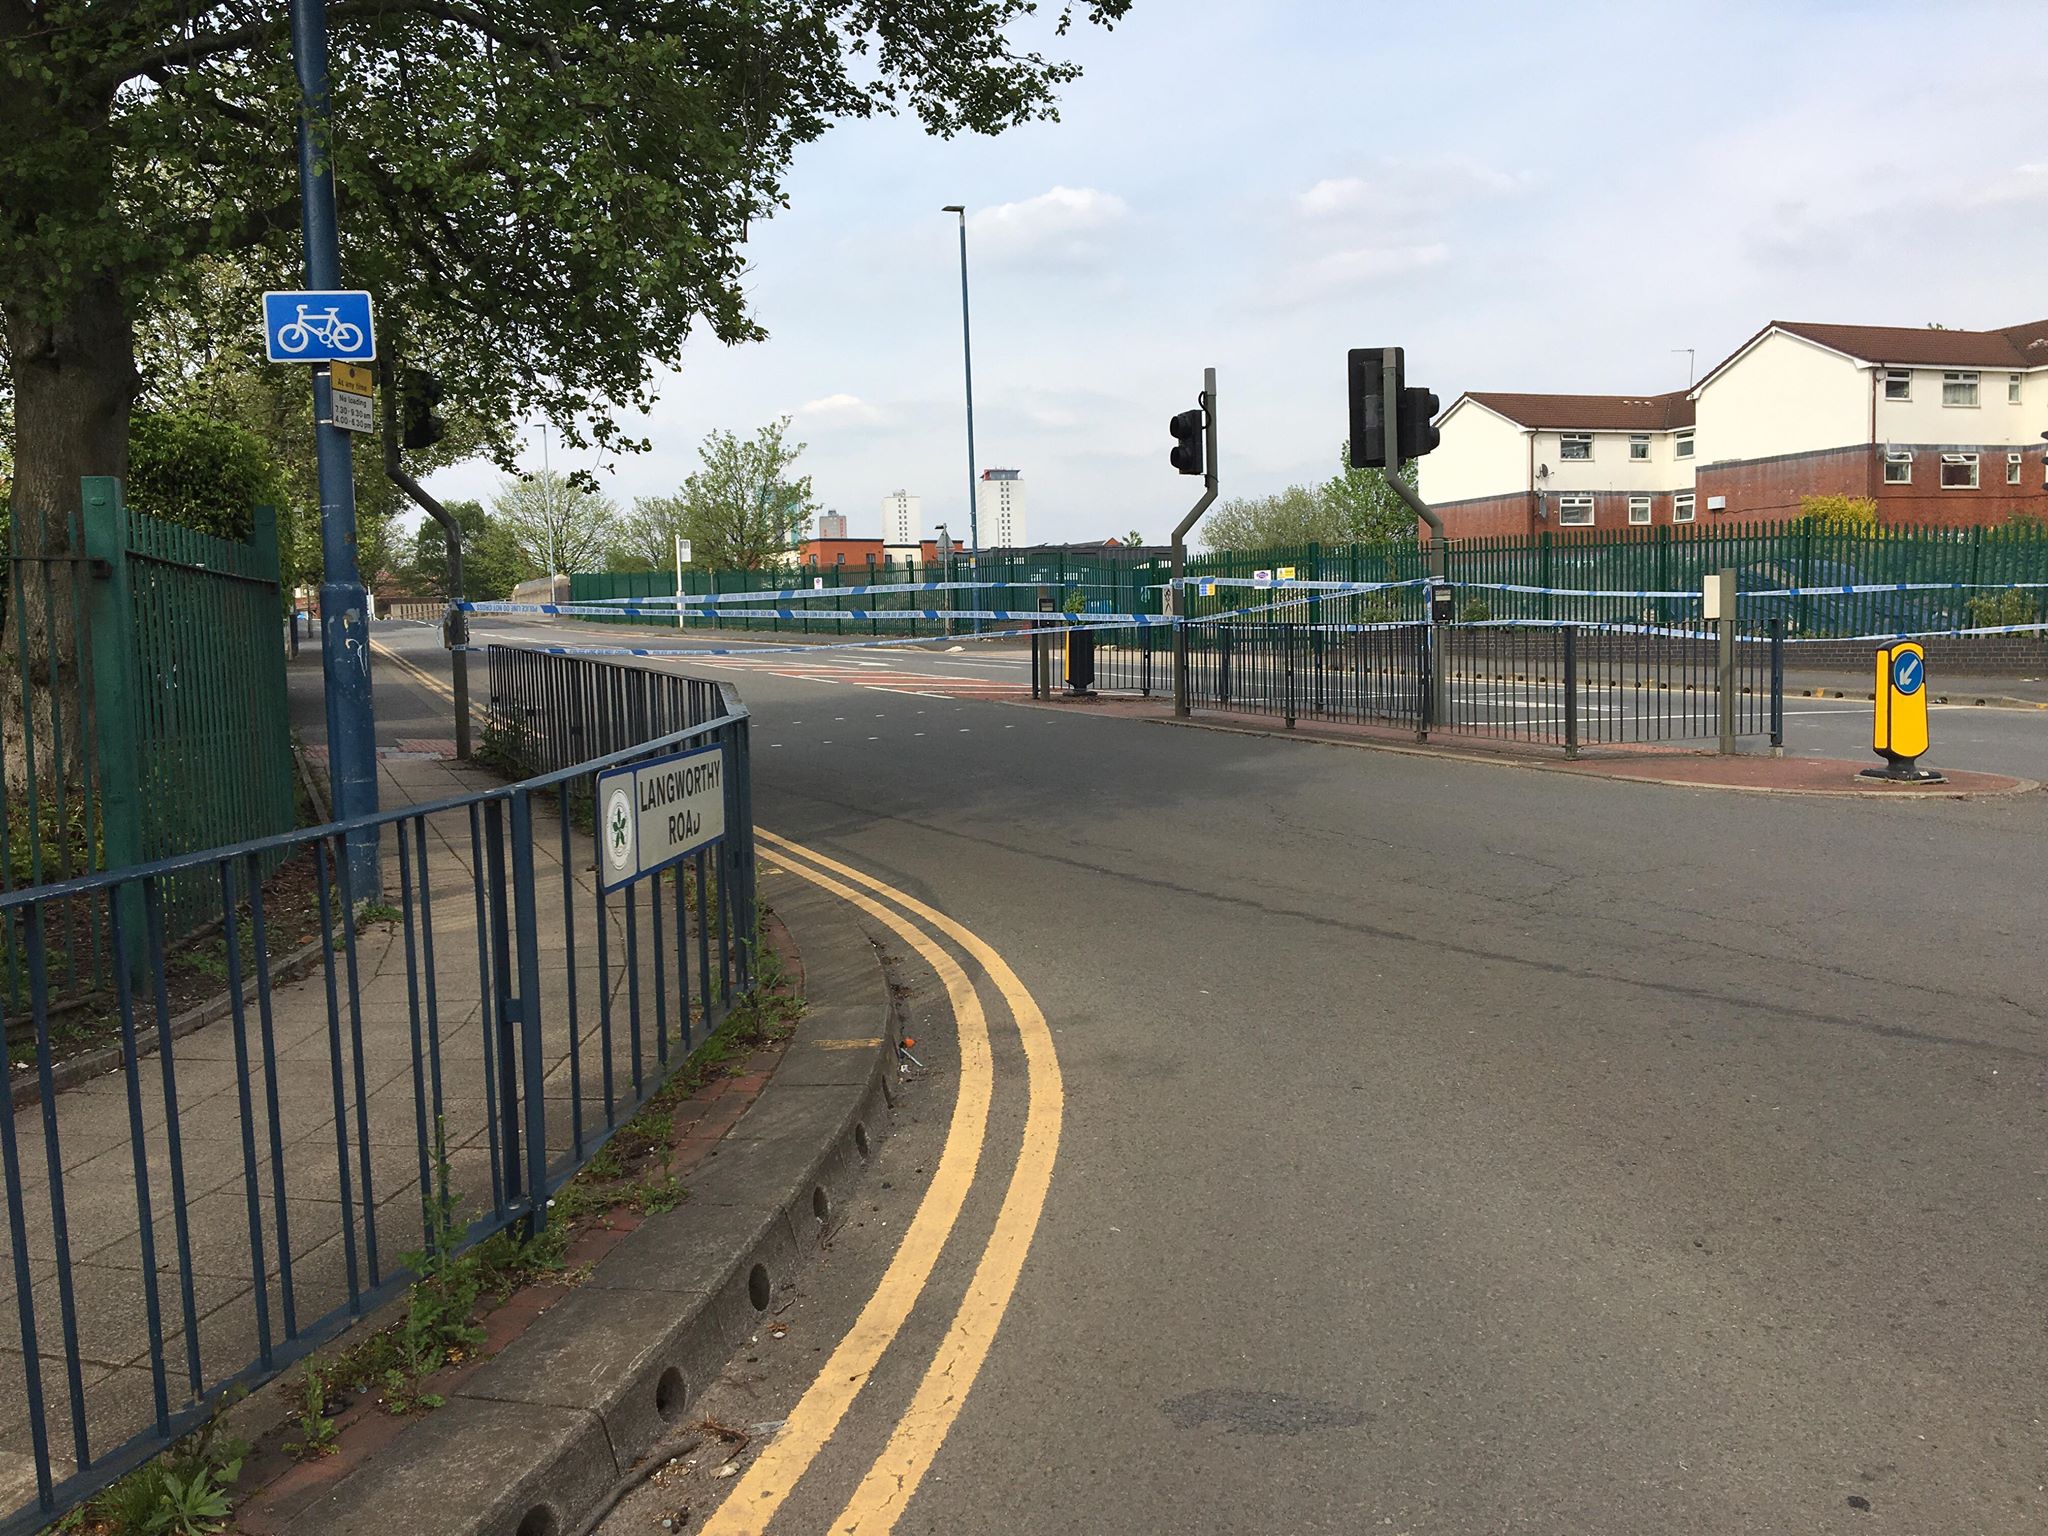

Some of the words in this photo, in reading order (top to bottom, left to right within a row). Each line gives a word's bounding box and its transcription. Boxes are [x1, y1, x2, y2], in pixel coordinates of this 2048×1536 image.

[339, 394, 347, 402] No
[348, 396, 366, 408] loading
[640, 760, 720, 812] LANGWORTHY
